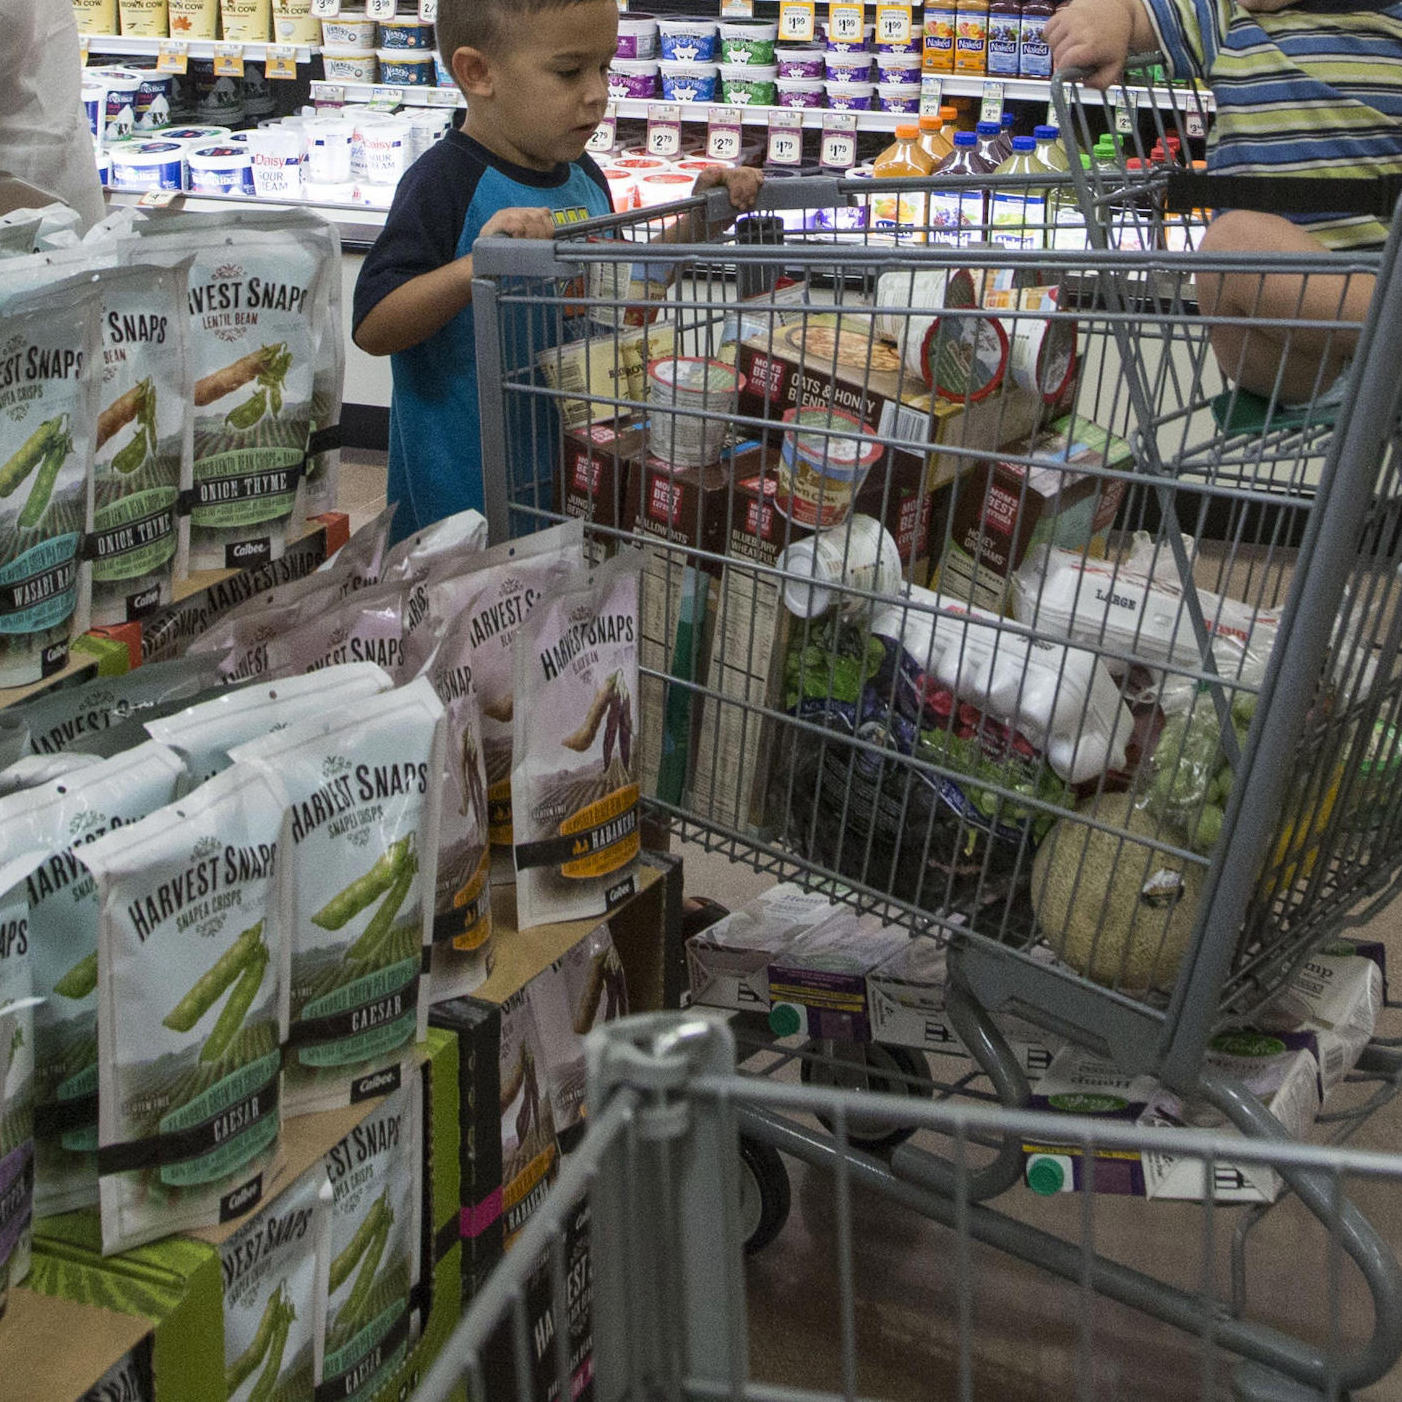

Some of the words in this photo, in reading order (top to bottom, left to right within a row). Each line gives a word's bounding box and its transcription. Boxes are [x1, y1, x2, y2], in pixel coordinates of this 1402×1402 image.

[255, 154, 284, 168] Daisy
[108, 311, 168, 345] SNAPS
[202, 313, 232, 330] LENTIL
[235, 312, 258, 326] BEAN
[26, 346, 84, 380] SNAPS
[788, 388, 826, 408] BEND
[201, 480, 238, 502] ONION
[244, 472, 287, 496] THYME
[98, 525, 132, 556] ONION
[136, 515, 170, 542] THYME
[234, 541, 266, 558] Calbee
[732, 529, 777, 551] BLUEBRRY
[968, 526, 996, 549] HOEY
[14, 573, 54, 607] WASABI
[540, 623, 589, 681] HARVEST
[587, 615, 634, 646] SNAPS
[292, 778, 354, 845] HARVEST
[356, 761, 428, 801] SNAPS
[591, 811, 636, 849] HABANERO
[128, 852, 222, 943] HARVEST
[225, 841, 277, 887] SNAPS
[175, 901, 210, 937] SNAPEA
[210, 890, 242, 913] CRISPS
[352, 995, 401, 1032] CAESAR
[359, 1071, 394, 1092] Calbee
[213, 1099, 260, 1144] CAESAR
